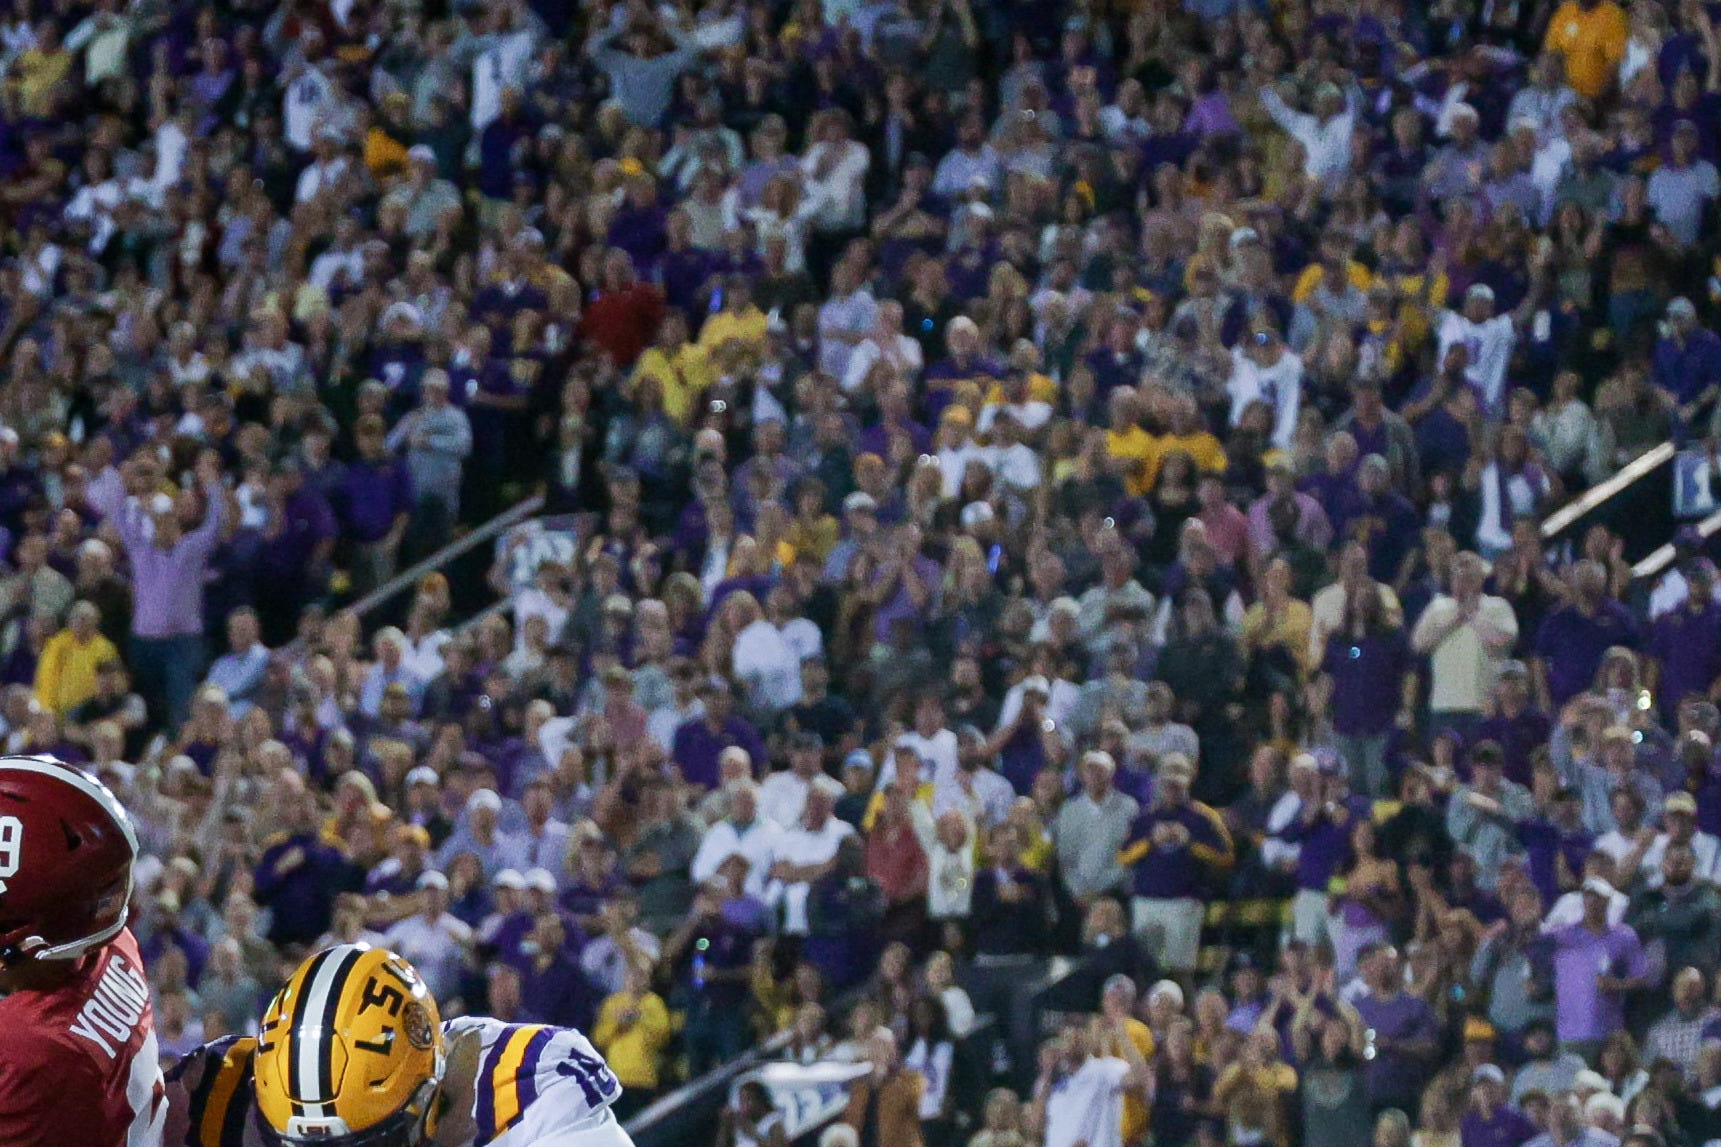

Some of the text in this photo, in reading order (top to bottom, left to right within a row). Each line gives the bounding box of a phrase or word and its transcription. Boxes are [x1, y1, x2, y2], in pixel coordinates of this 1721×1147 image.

[69, 954, 150, 1059] YOUNG
[354, 959, 426, 1056] LSU
[556, 1047, 617, 1109] 18
